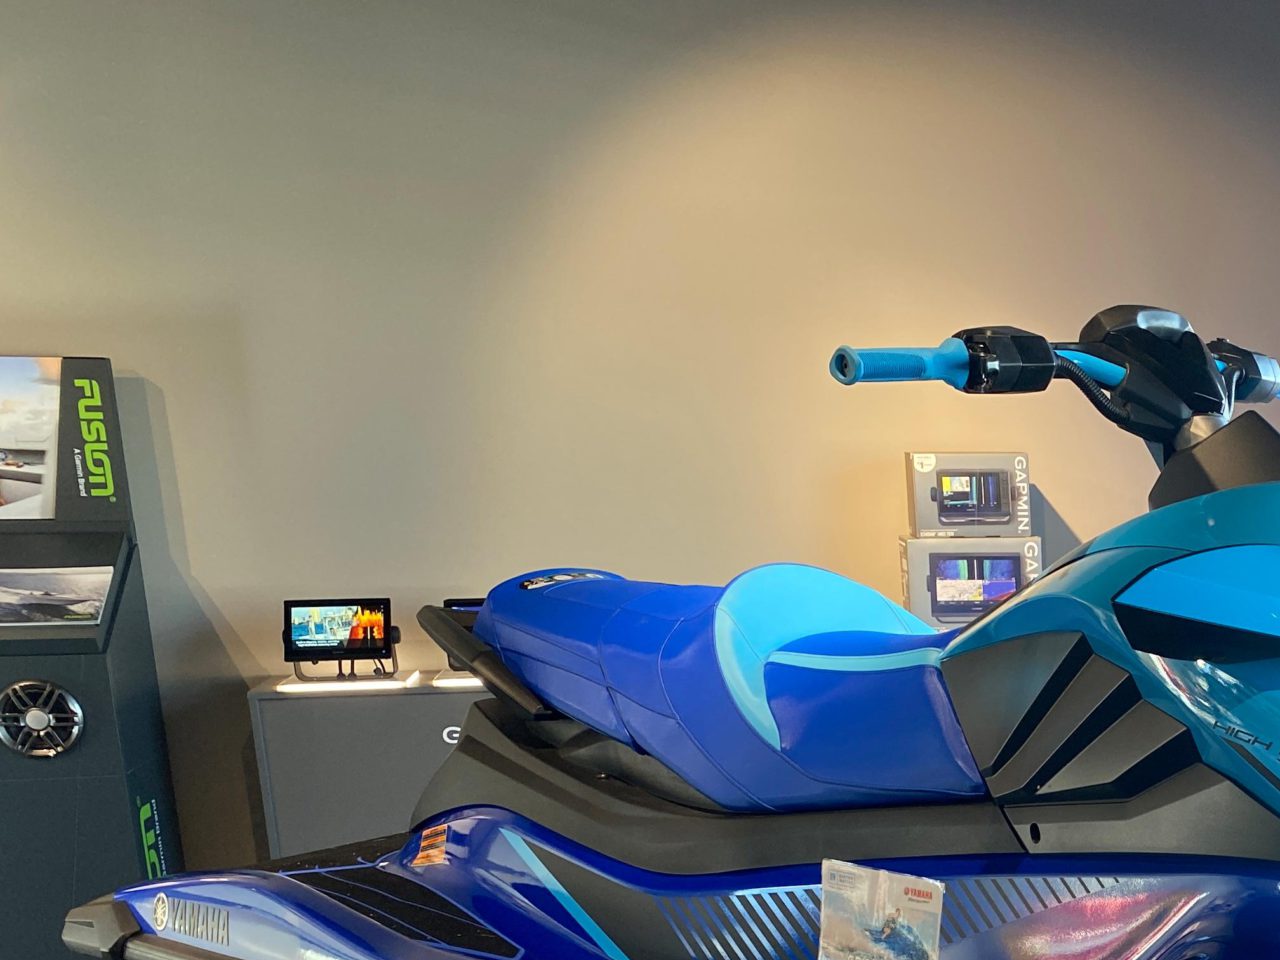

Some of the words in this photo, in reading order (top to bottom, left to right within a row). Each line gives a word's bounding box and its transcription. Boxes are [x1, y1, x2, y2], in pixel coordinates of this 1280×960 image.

[74, 379, 114, 497] FUSION
[1014, 456, 1030, 534] GARMIN
[1213, 720, 1274, 750] HIGH
[170, 897, 230, 946] YAMAHA
